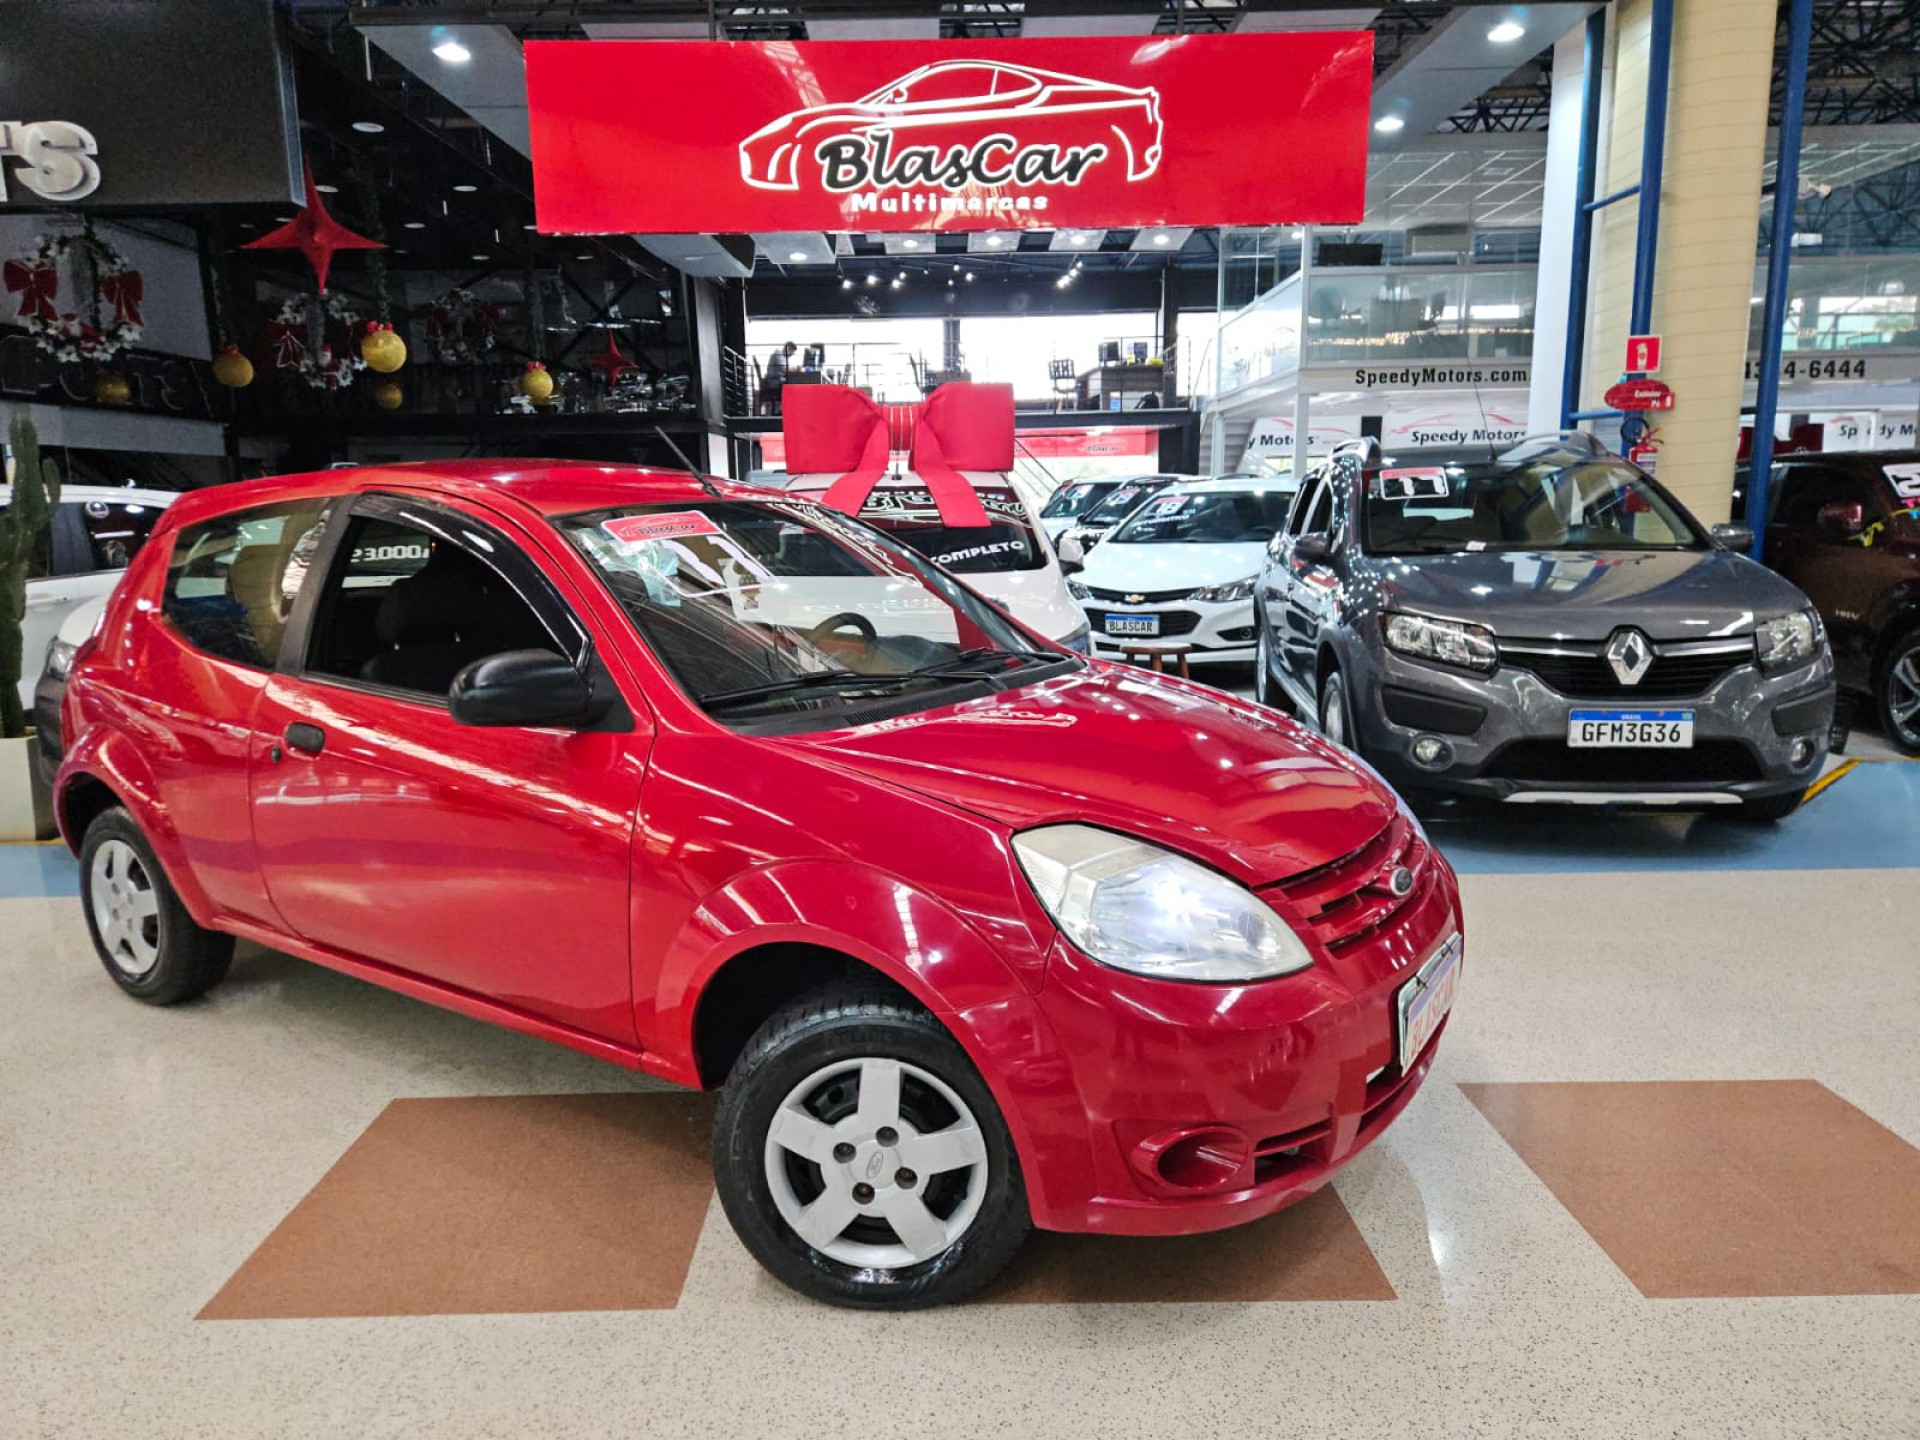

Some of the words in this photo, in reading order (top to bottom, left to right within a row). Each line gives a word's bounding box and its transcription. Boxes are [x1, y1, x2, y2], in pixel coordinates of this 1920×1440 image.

[815, 129, 1107, 191] BlasCar
[851, 192, 1049, 212] Multimarcas
[1355, 368, 1528, 387] SpeedyMotors.com
[1259, 434, 1314, 446] Mots
[1411, 430, 1468, 446] Speedy
[929, 540, 1025, 565] COMPLETO
[1109, 620, 1153, 632] BLASCAR
[1581, 722, 1682, 744] GFM3G36
